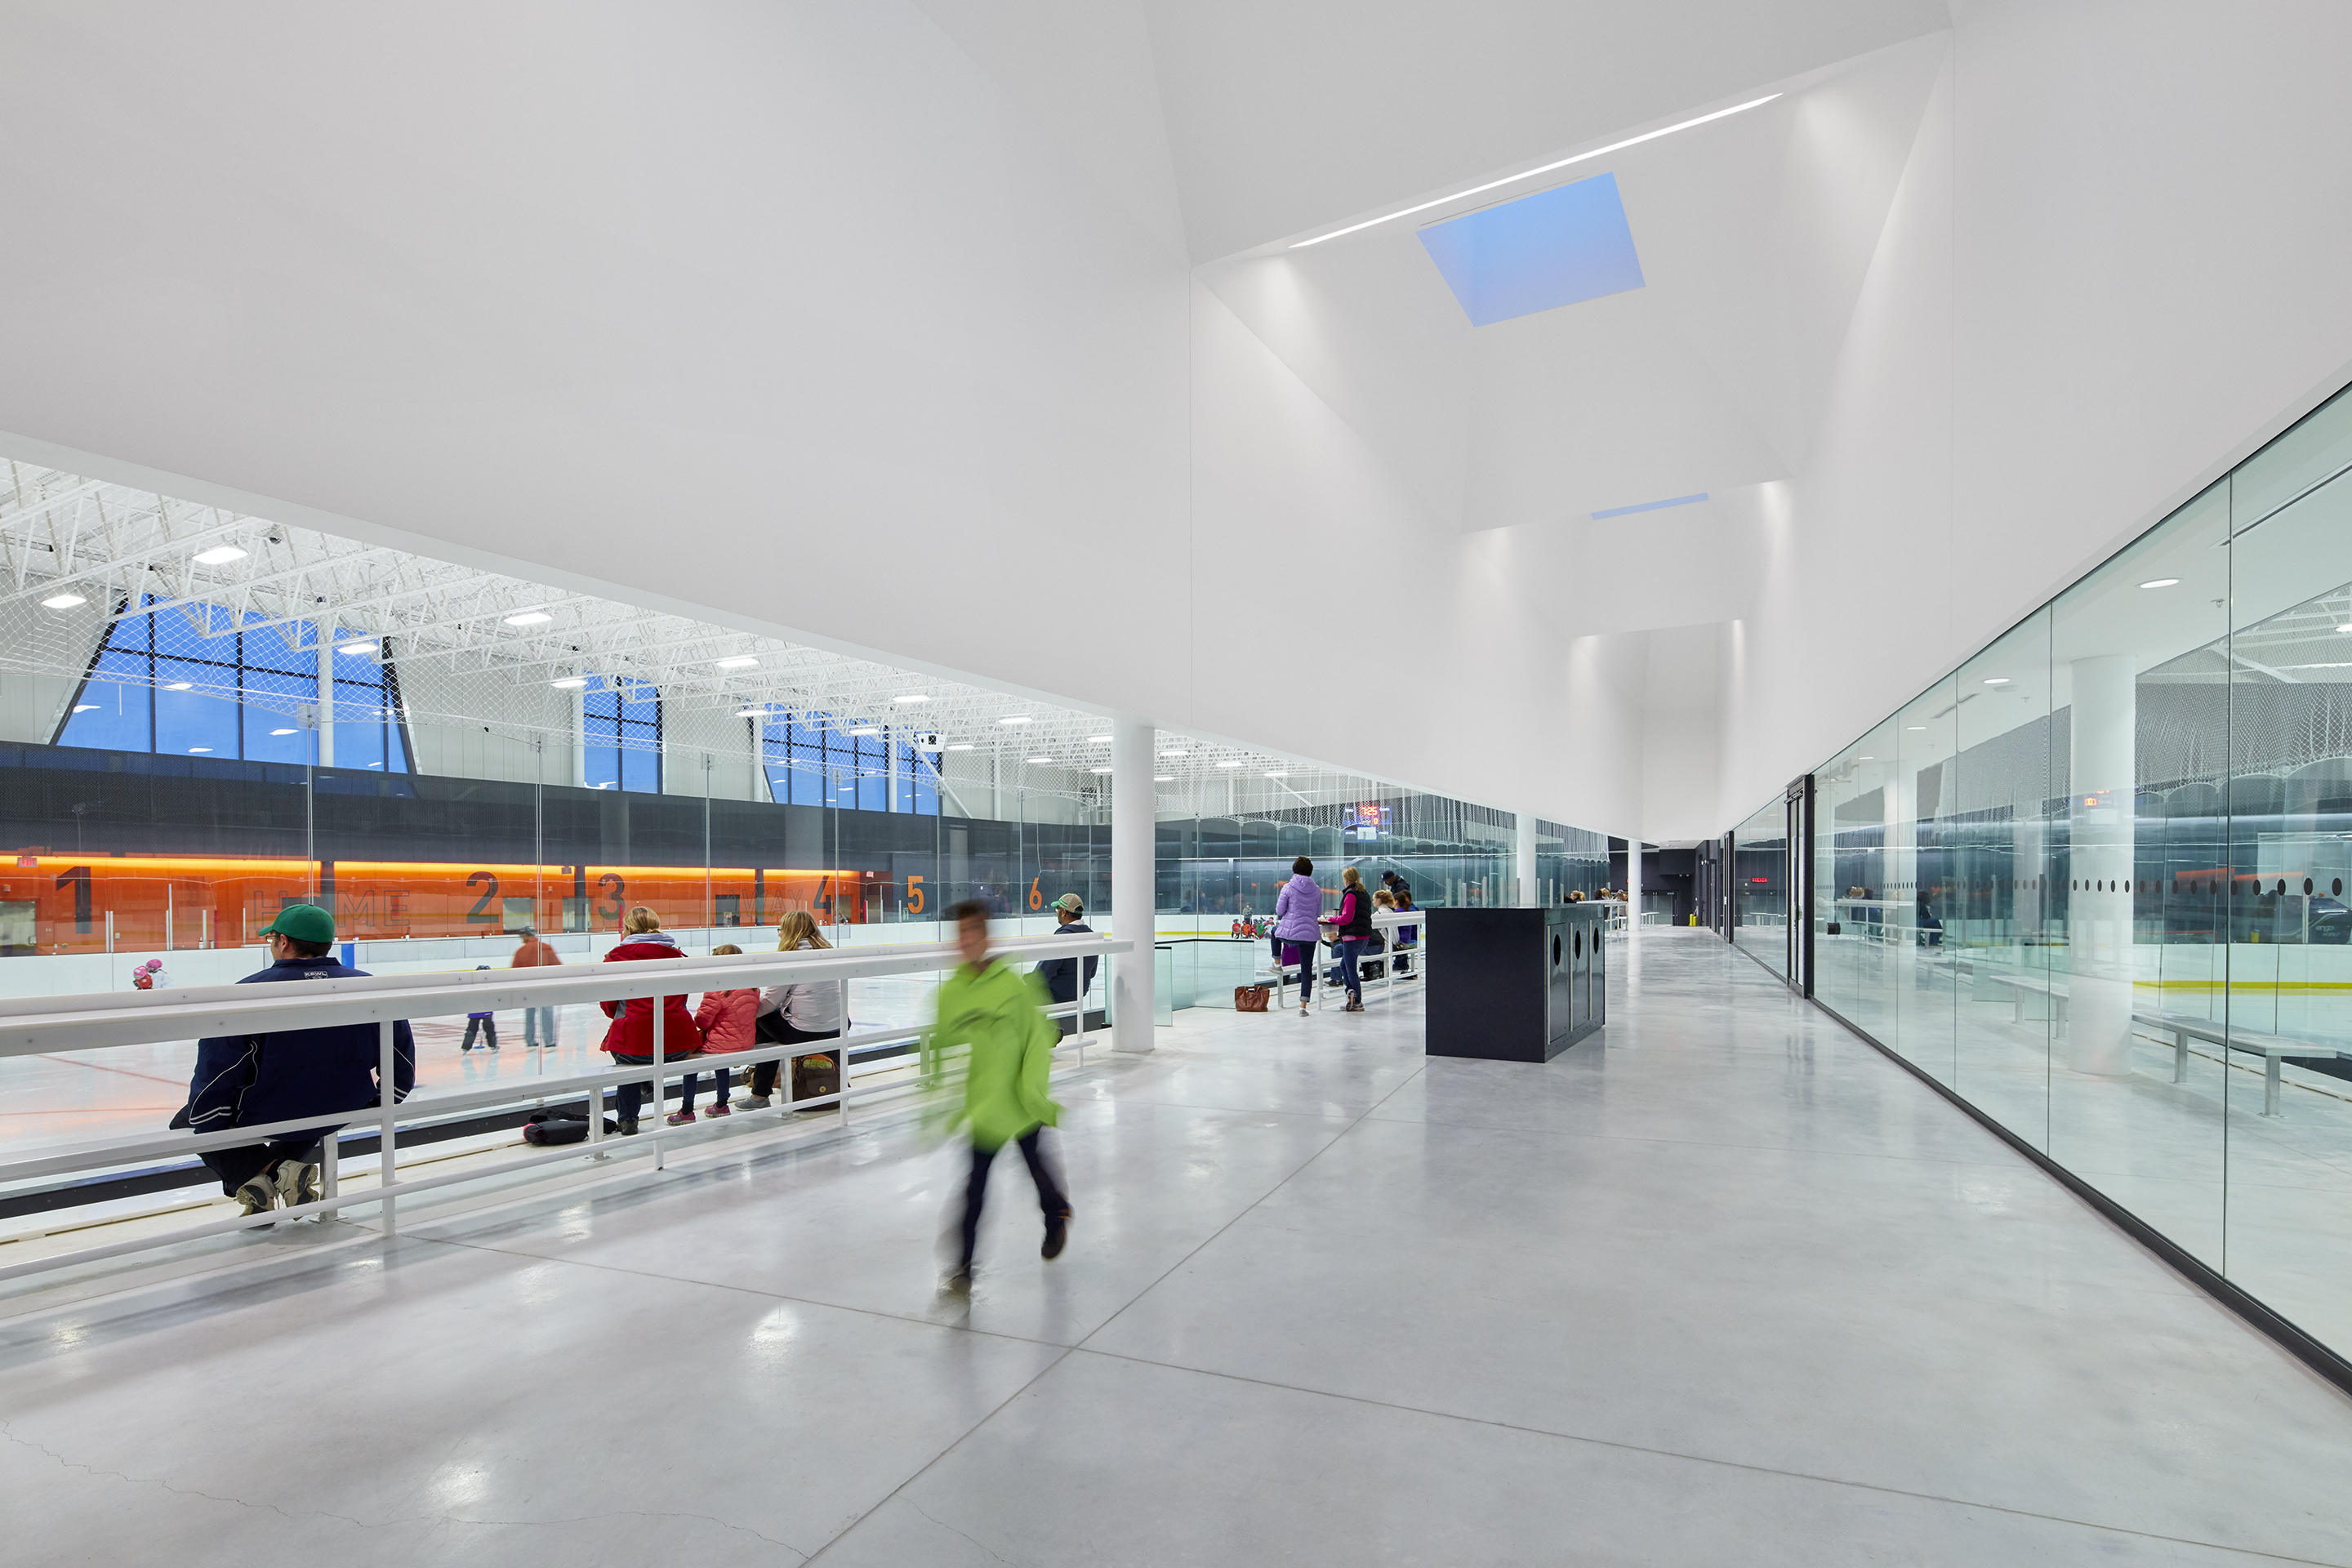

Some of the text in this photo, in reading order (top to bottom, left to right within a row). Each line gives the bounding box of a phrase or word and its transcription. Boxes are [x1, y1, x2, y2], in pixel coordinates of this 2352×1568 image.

[1361, 806, 1378, 816] 7:25
[56, 866, 92, 933] 1
[466, 871, 500, 924] 2
[598, 873, 626, 920] 3
[813, 875, 831, 915] 4
[907, 875, 924, 914] 5
[1029, 877, 1043, 911] 6
